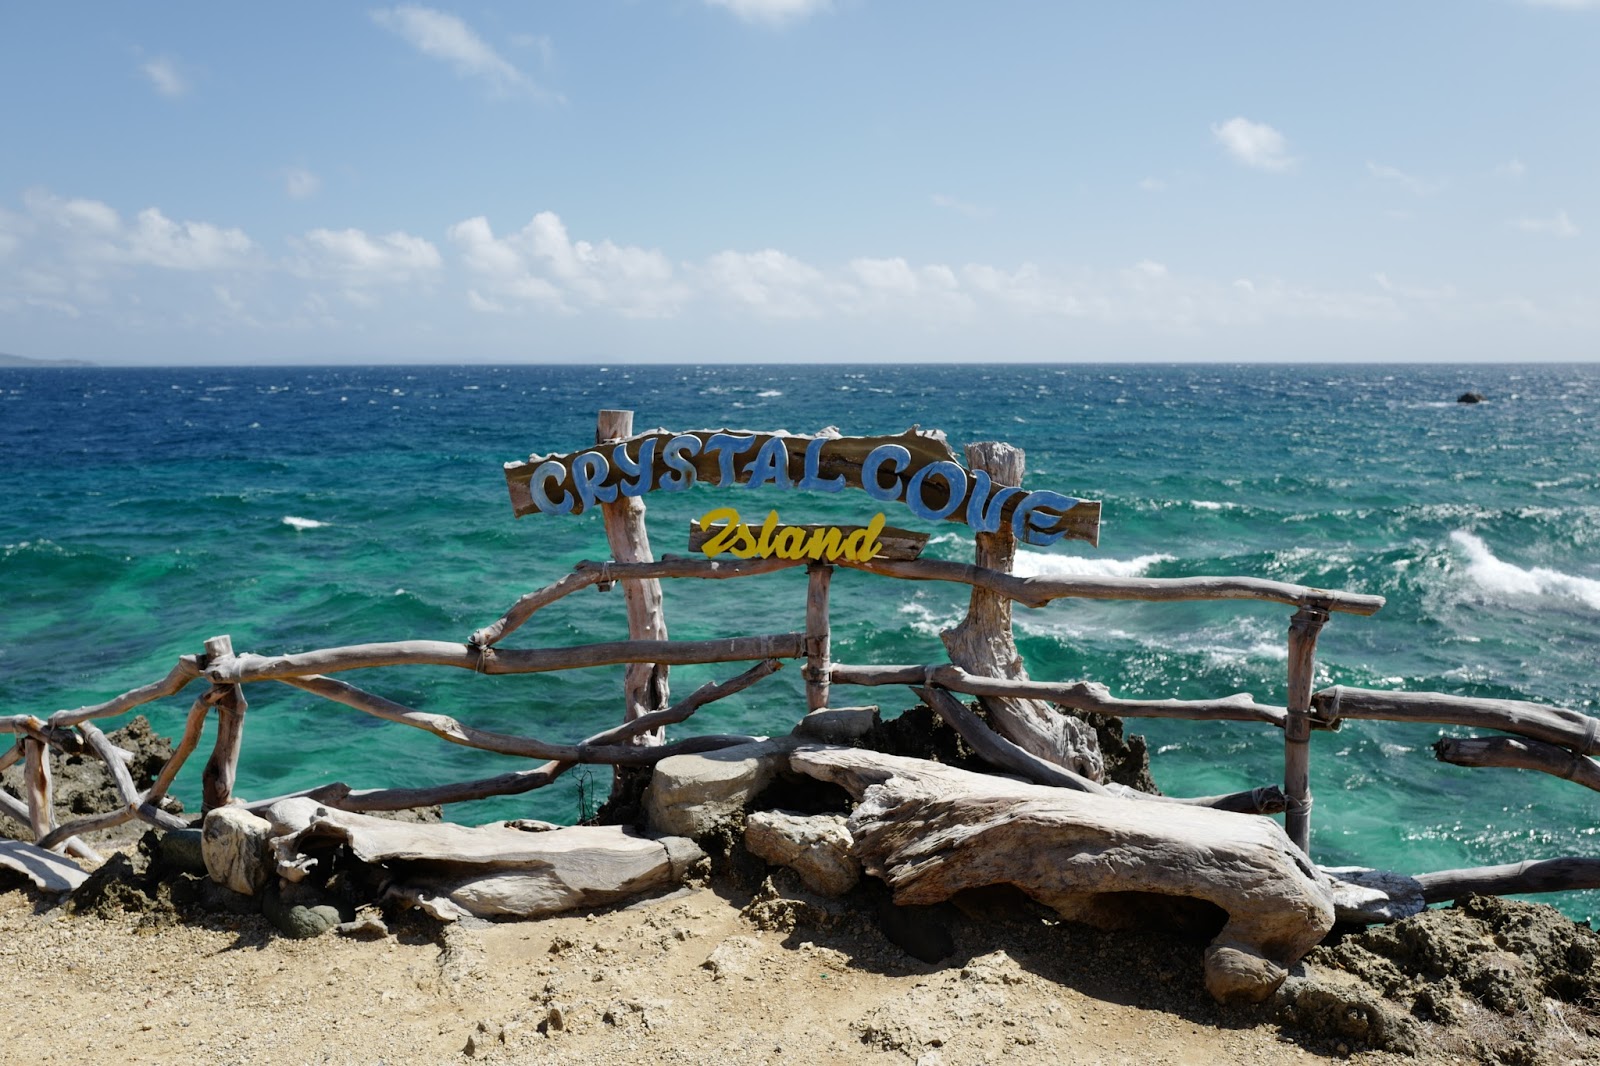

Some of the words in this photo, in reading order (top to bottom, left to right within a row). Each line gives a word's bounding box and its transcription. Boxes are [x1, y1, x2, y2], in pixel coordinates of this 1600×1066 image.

[530, 433, 845, 515] CRYSTAL
[863, 444, 1077, 546] COVE
[701, 508, 886, 562] Island
